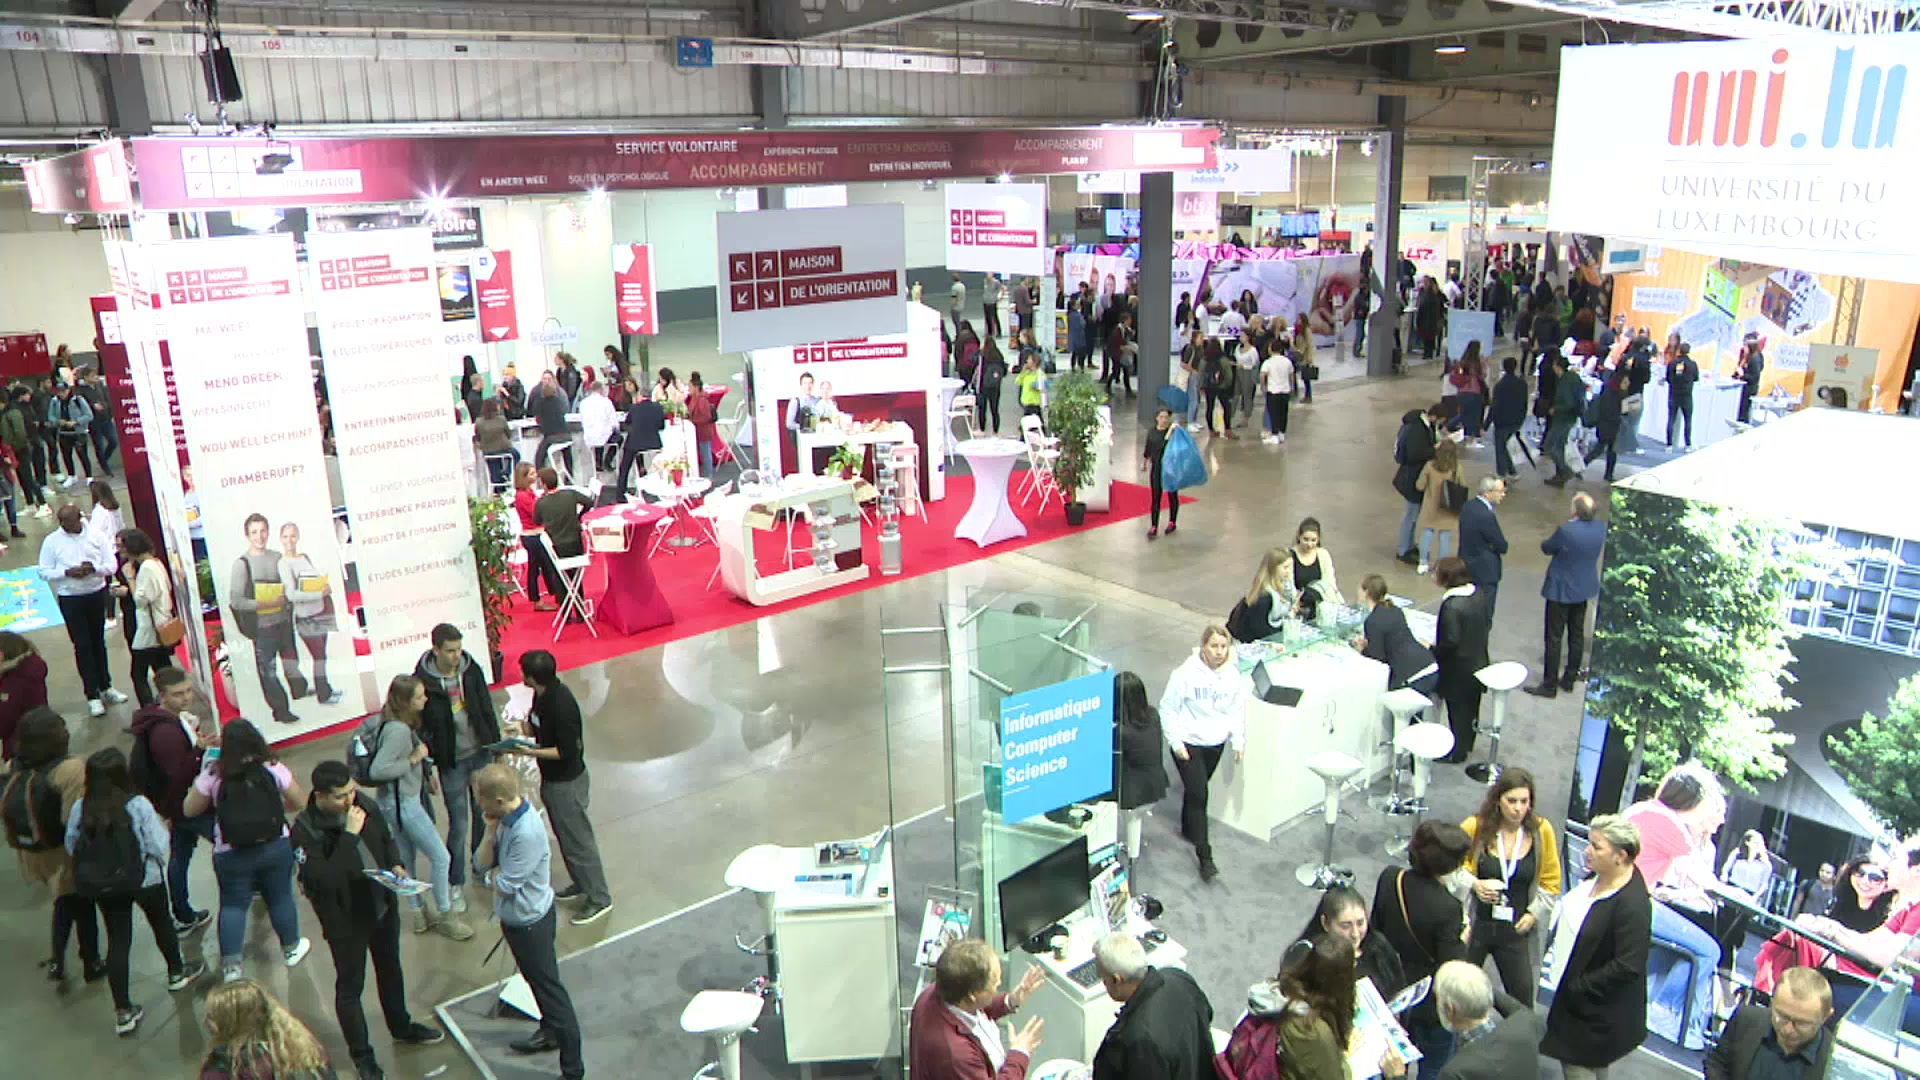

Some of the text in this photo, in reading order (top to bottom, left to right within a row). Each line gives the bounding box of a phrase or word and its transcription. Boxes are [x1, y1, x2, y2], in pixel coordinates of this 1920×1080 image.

[16, 31, 39, 42] 104
[262, 40, 280, 50] 105
[1668, 46, 1907, 149] uni.lu
[616, 140, 738, 155] SERVICE VOLONTAIRE
[1014, 138, 1103, 152] ACCOMPAGNEMENT
[690, 161, 825, 180] ACCOMPAGNEMENT
[869, 160, 952, 172] ENTRETIEN INDIVIDUEL
[1661, 175, 1887, 204] UNIVERSITÉ DU
[1657, 208, 1879, 241] LUXEMBOURG
[789, 255, 834, 270] MAISON
[790, 278, 891, 299] DE L'ORIENTATION
[381, 312, 431, 325] FORMATION
[344, 407, 448, 432] ENTRETIEN INDIVIDUEL
[348, 431, 449, 456] ACCOMPAGNEMENT
[415, 496, 457, 511] PRATIQUE
[362, 532, 394, 546] PROJET
[408, 521, 457, 537] FORMATION
[380, 631, 429, 651] ENTRETIEN
[1004, 696, 1101, 736] Informatique
[1004, 727, 1078, 761] Computer
[1004, 755, 1068, 786] Science
